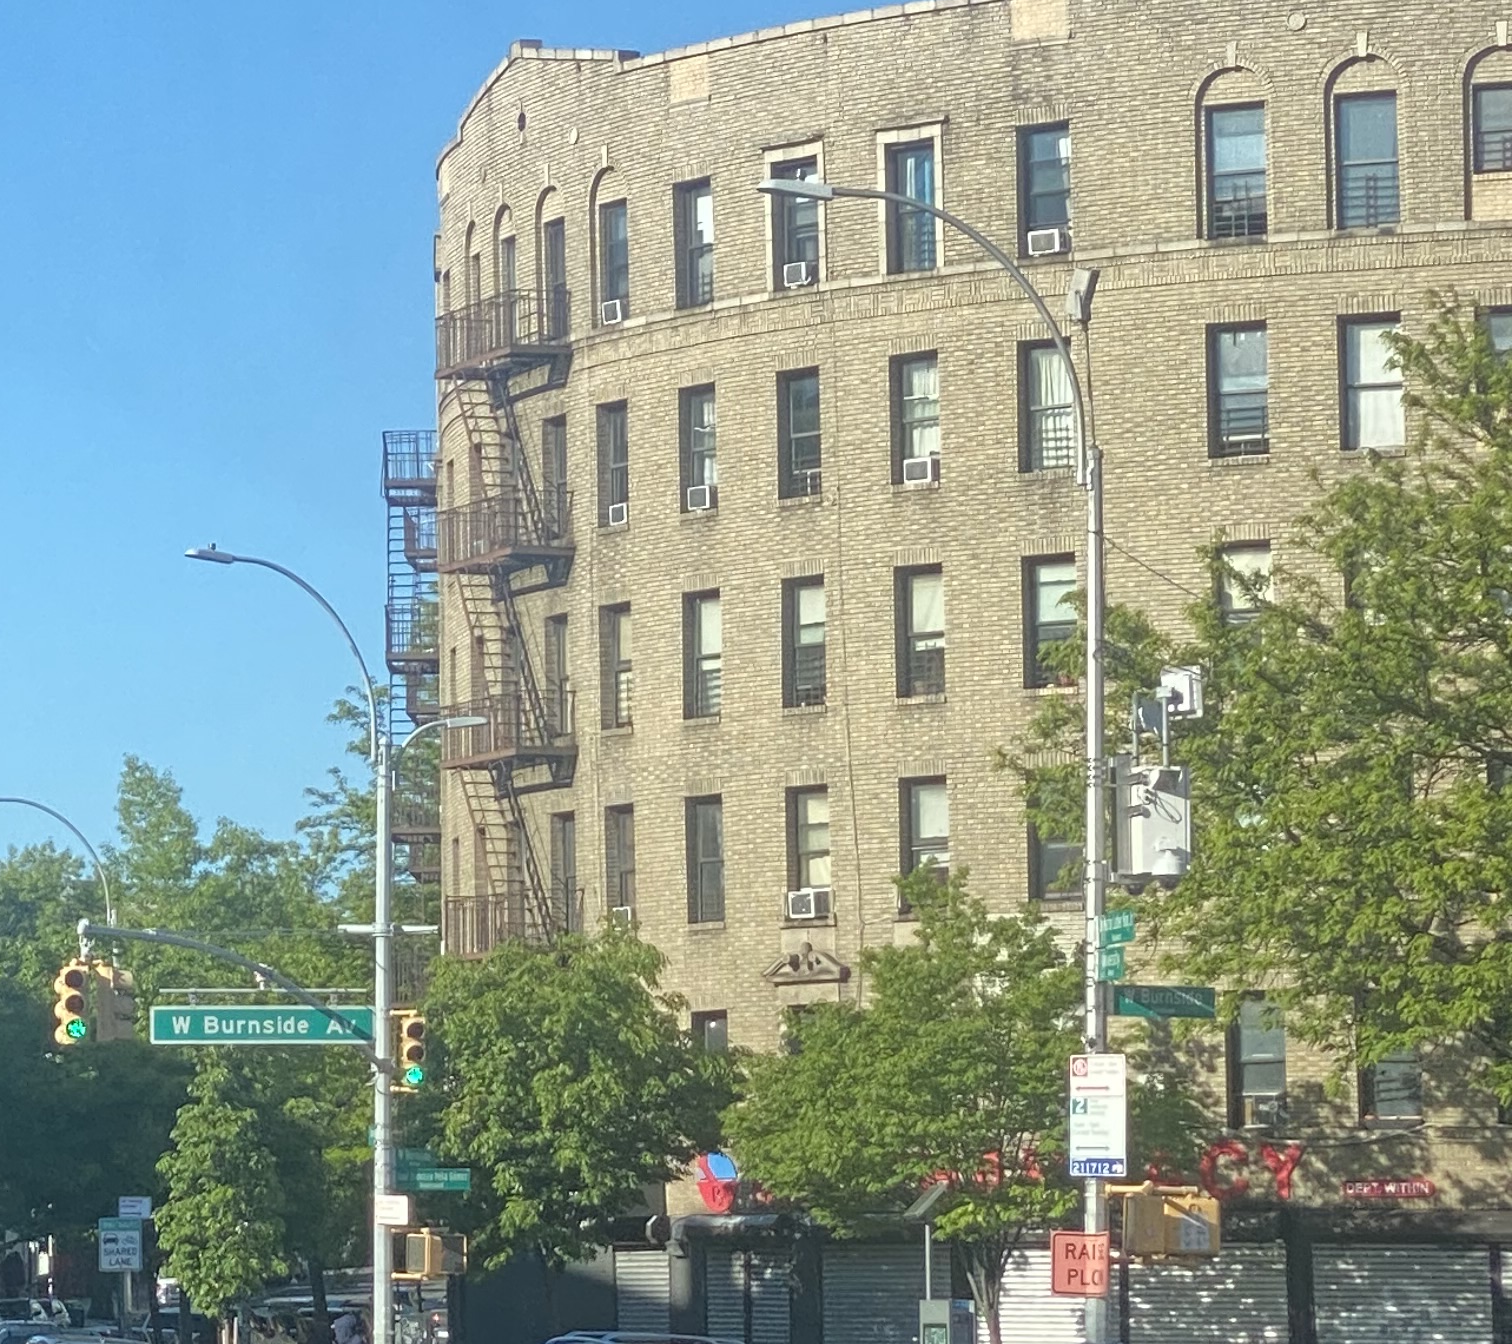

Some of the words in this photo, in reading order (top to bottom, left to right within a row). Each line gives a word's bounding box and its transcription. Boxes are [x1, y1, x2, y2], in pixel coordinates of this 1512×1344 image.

[172, 1015, 191, 1035] W
[204, 1015, 310, 1035] Burnside
[326, 1016, 356, 1036] Av
[1072, 1162, 1110, 1175] 211712
[1383, 1181, 1430, 1195] WITHIN
[103, 1247, 137, 1256] SHARED
[1064, 1242, 1105, 1261] RAI
[109, 1258, 132, 1267] LANE
